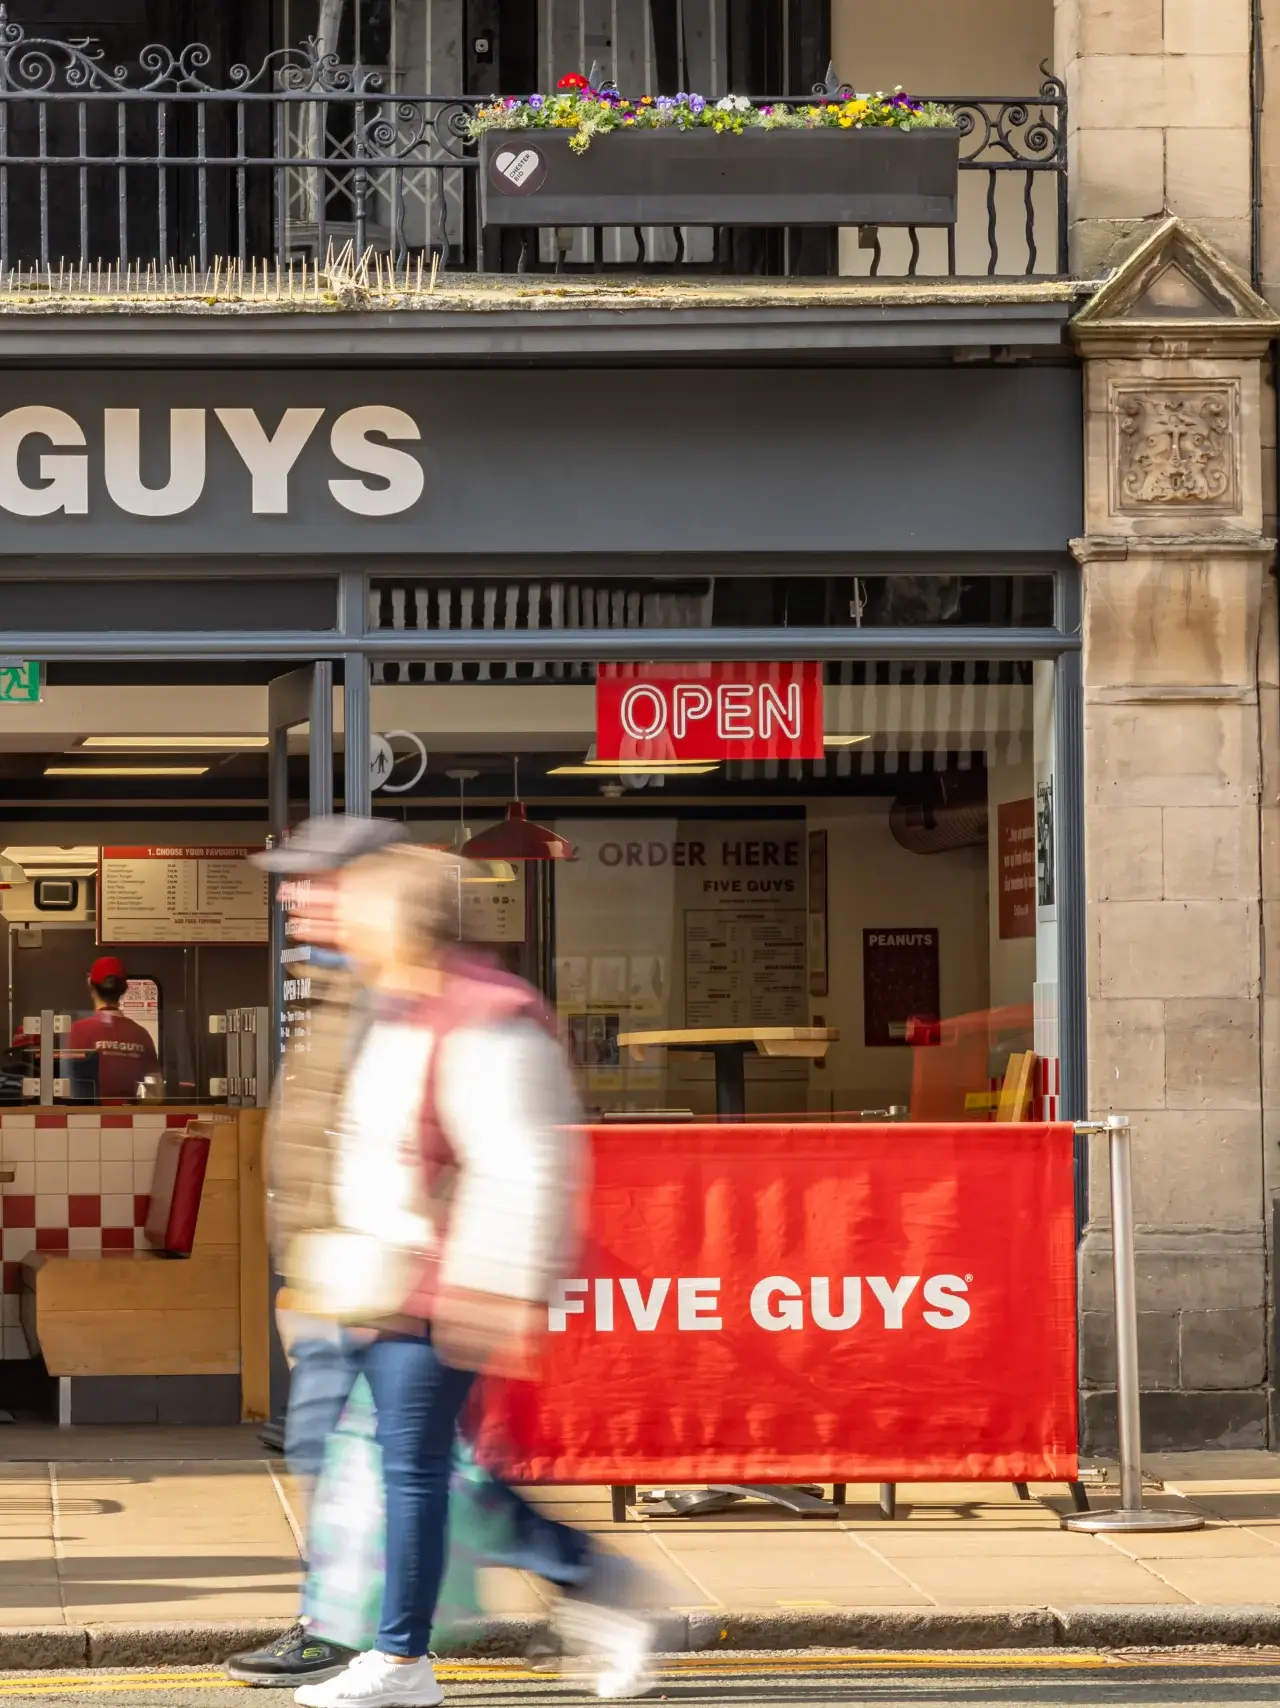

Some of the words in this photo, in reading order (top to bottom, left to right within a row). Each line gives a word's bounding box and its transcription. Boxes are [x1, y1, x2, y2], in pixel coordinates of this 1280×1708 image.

[509, 153, 531, 178] CHESTER
[620, 683, 802, 741] OPEN
[156, 848, 183, 856] CHOOSE
[185, 848, 204, 856] YOUR
[598, 841, 706, 867] ORDER
[722, 841, 800, 867] HERE
[703, 880, 742, 892] FIVE
[747, 880, 795, 892] GUYS
[869, 934, 933, 946] PEANUTS
[95, 1040, 119, 1050] FIVE
[548, 1276, 723, 1332] FIVE
